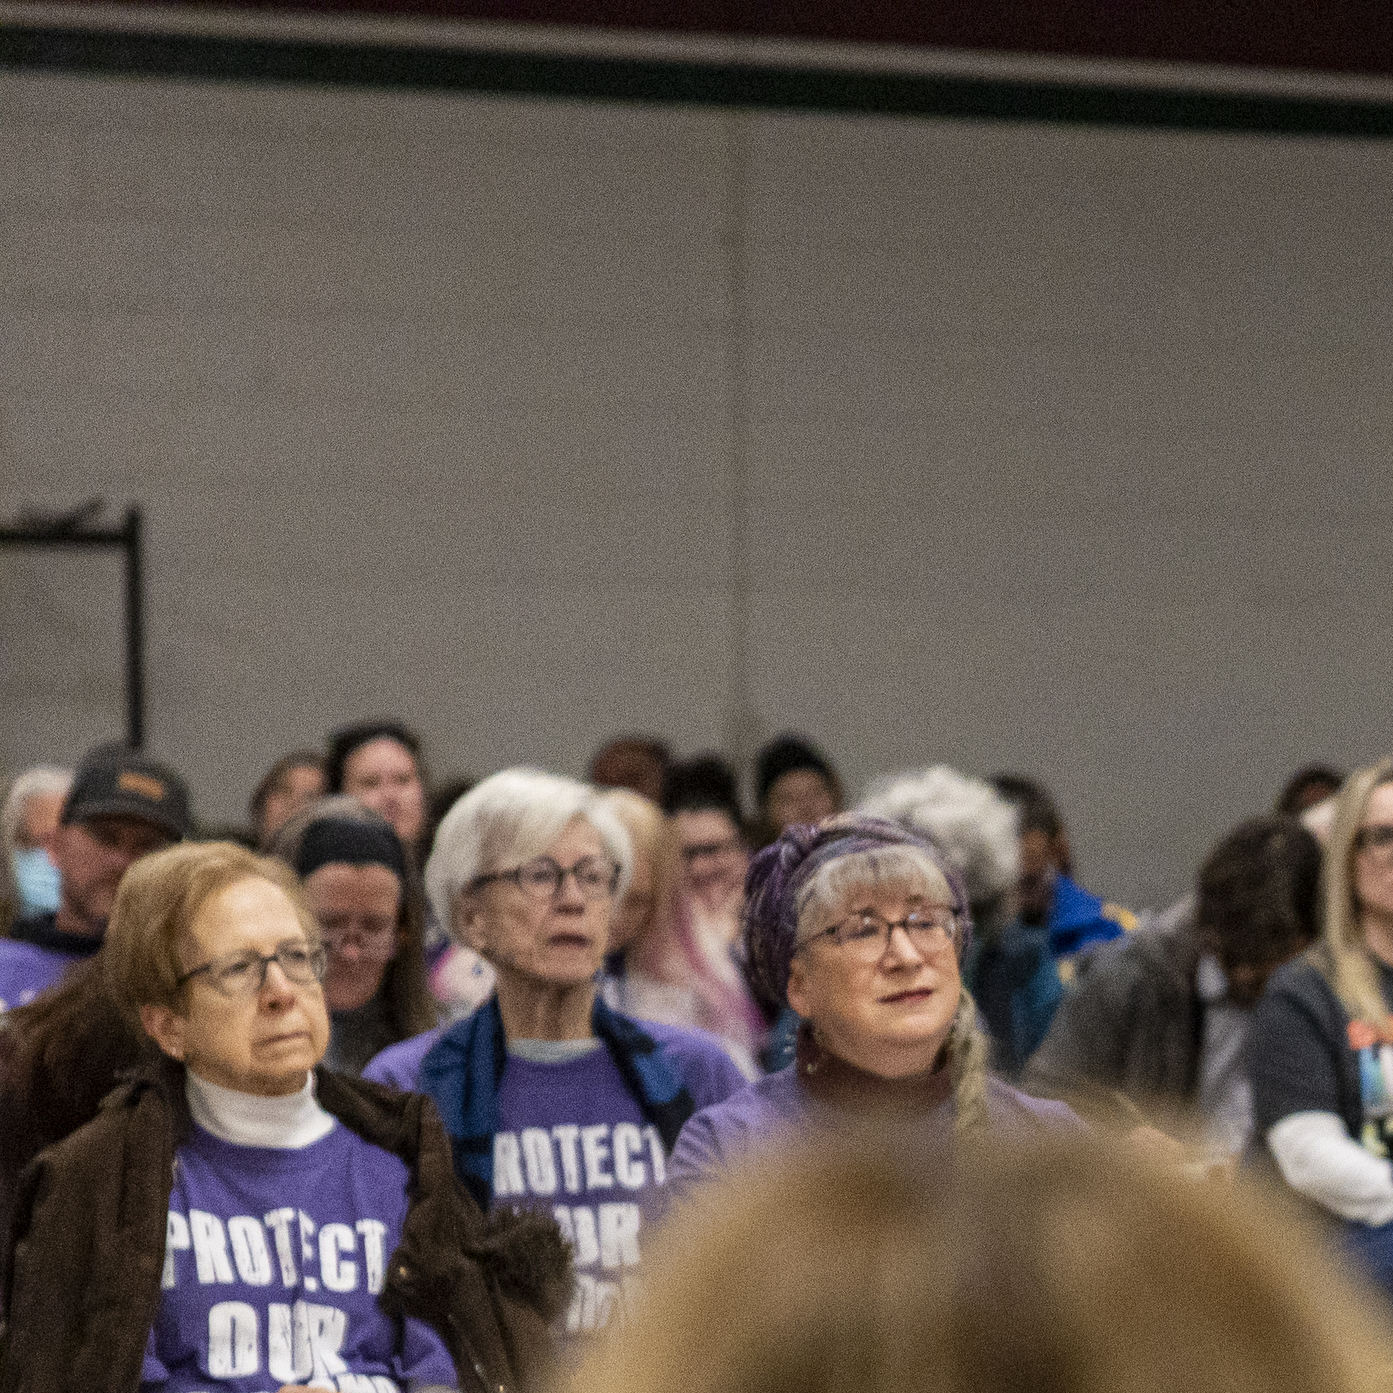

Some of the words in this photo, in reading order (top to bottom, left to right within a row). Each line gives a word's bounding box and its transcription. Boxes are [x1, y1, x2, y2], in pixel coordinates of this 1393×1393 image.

[493, 1122, 667, 1196] ROTECT
[160, 1207, 386, 1295] PROTECT
[554, 1203, 641, 1268] UR
[207, 1300, 348, 1388] OUR
